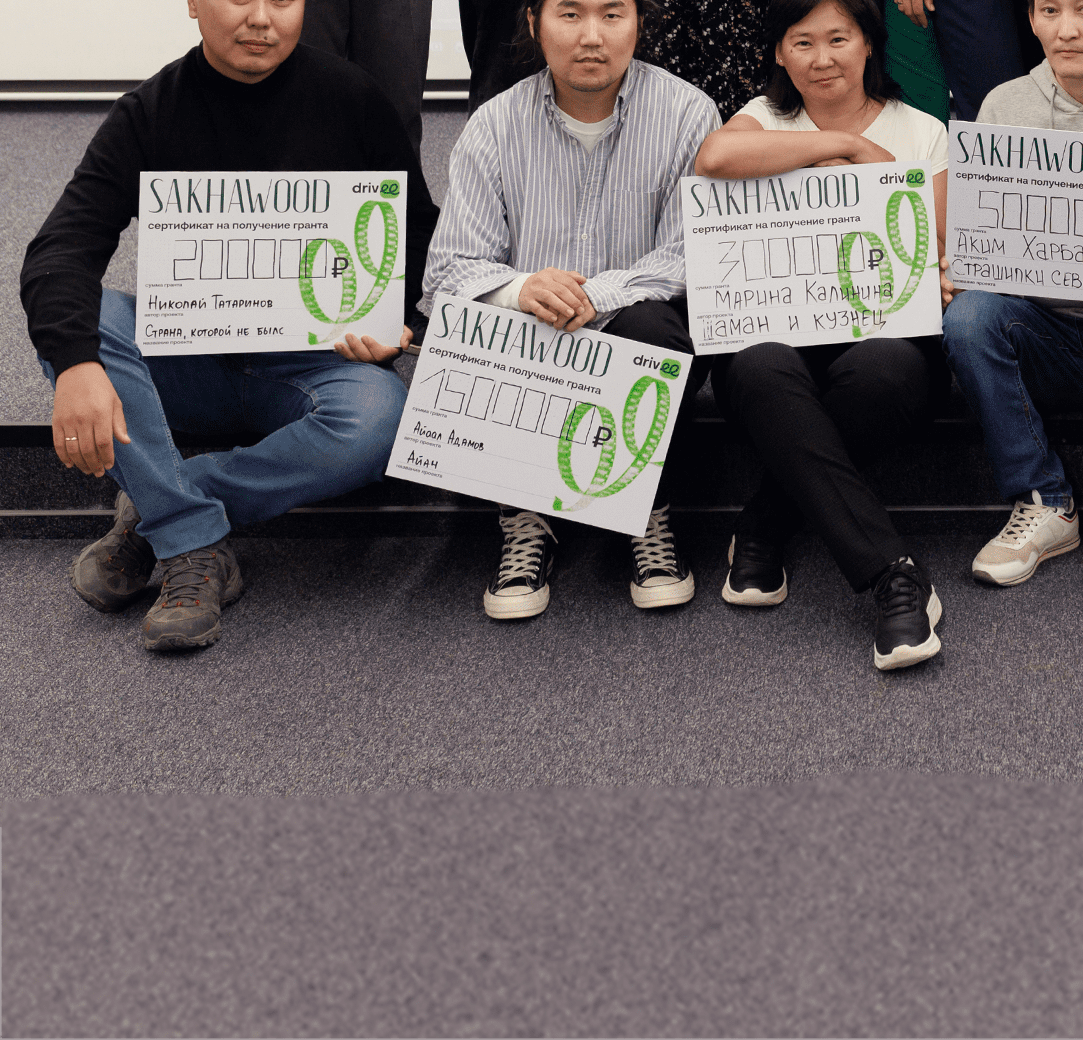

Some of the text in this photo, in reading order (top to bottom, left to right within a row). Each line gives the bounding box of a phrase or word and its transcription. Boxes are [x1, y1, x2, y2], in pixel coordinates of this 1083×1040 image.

[879, 171, 925, 185] drivee
[956, 171, 1014, 184] сертификат
[1017, 176, 1029, 184] на
[1031, 177, 1083, 190] получение
[149, 179, 330, 214] SAKHAWOOD
[352, 181, 400, 196] drivee
[690, 173, 860, 218] SAKHAWOOD
[148, 221, 328, 231] сертификат на получение гранта
[693, 215, 861, 234] сертификат на получение гранта
[433, 303, 613, 378] SAKHAWOOD
[429, 345, 602, 395] сертификат на получение гранта
[633, 355, 680, 376] drivee
